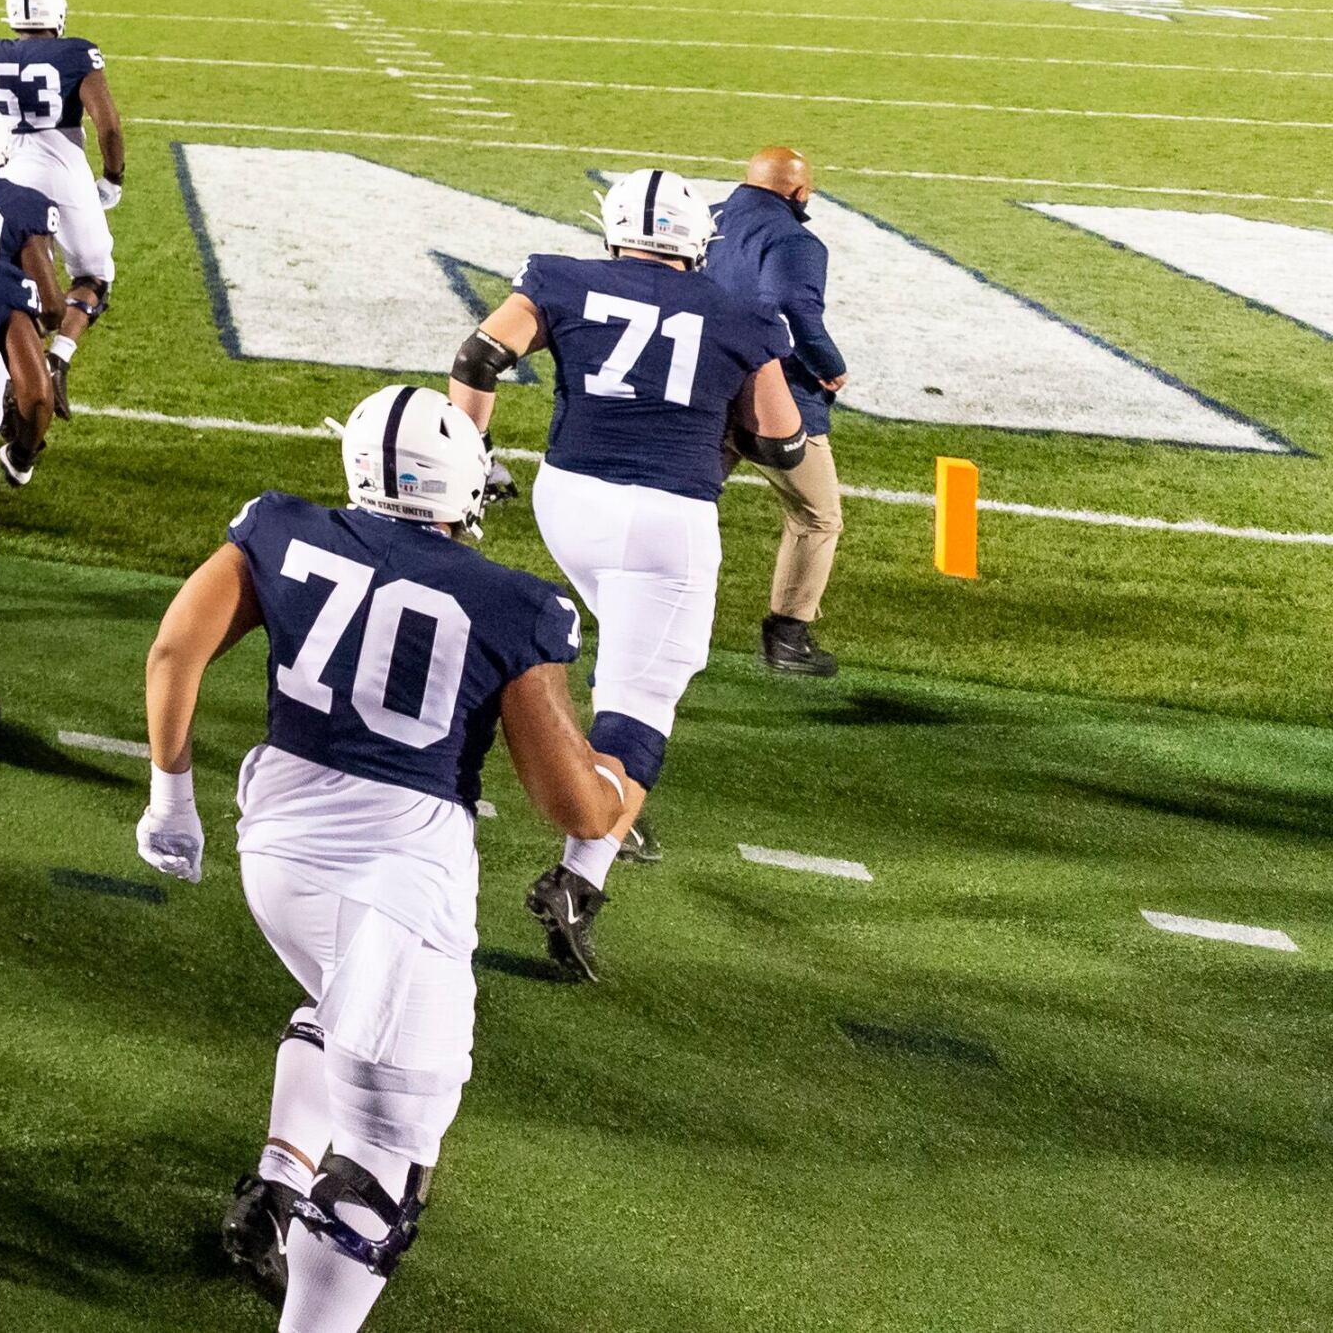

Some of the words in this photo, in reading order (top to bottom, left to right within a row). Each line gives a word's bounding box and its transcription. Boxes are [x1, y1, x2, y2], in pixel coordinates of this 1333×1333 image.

[582, 290, 706, 407] 71
[377, 500, 401, 514] STATE
[402, 506, 434, 519] UNITED
[275, 538, 472, 750] 70
